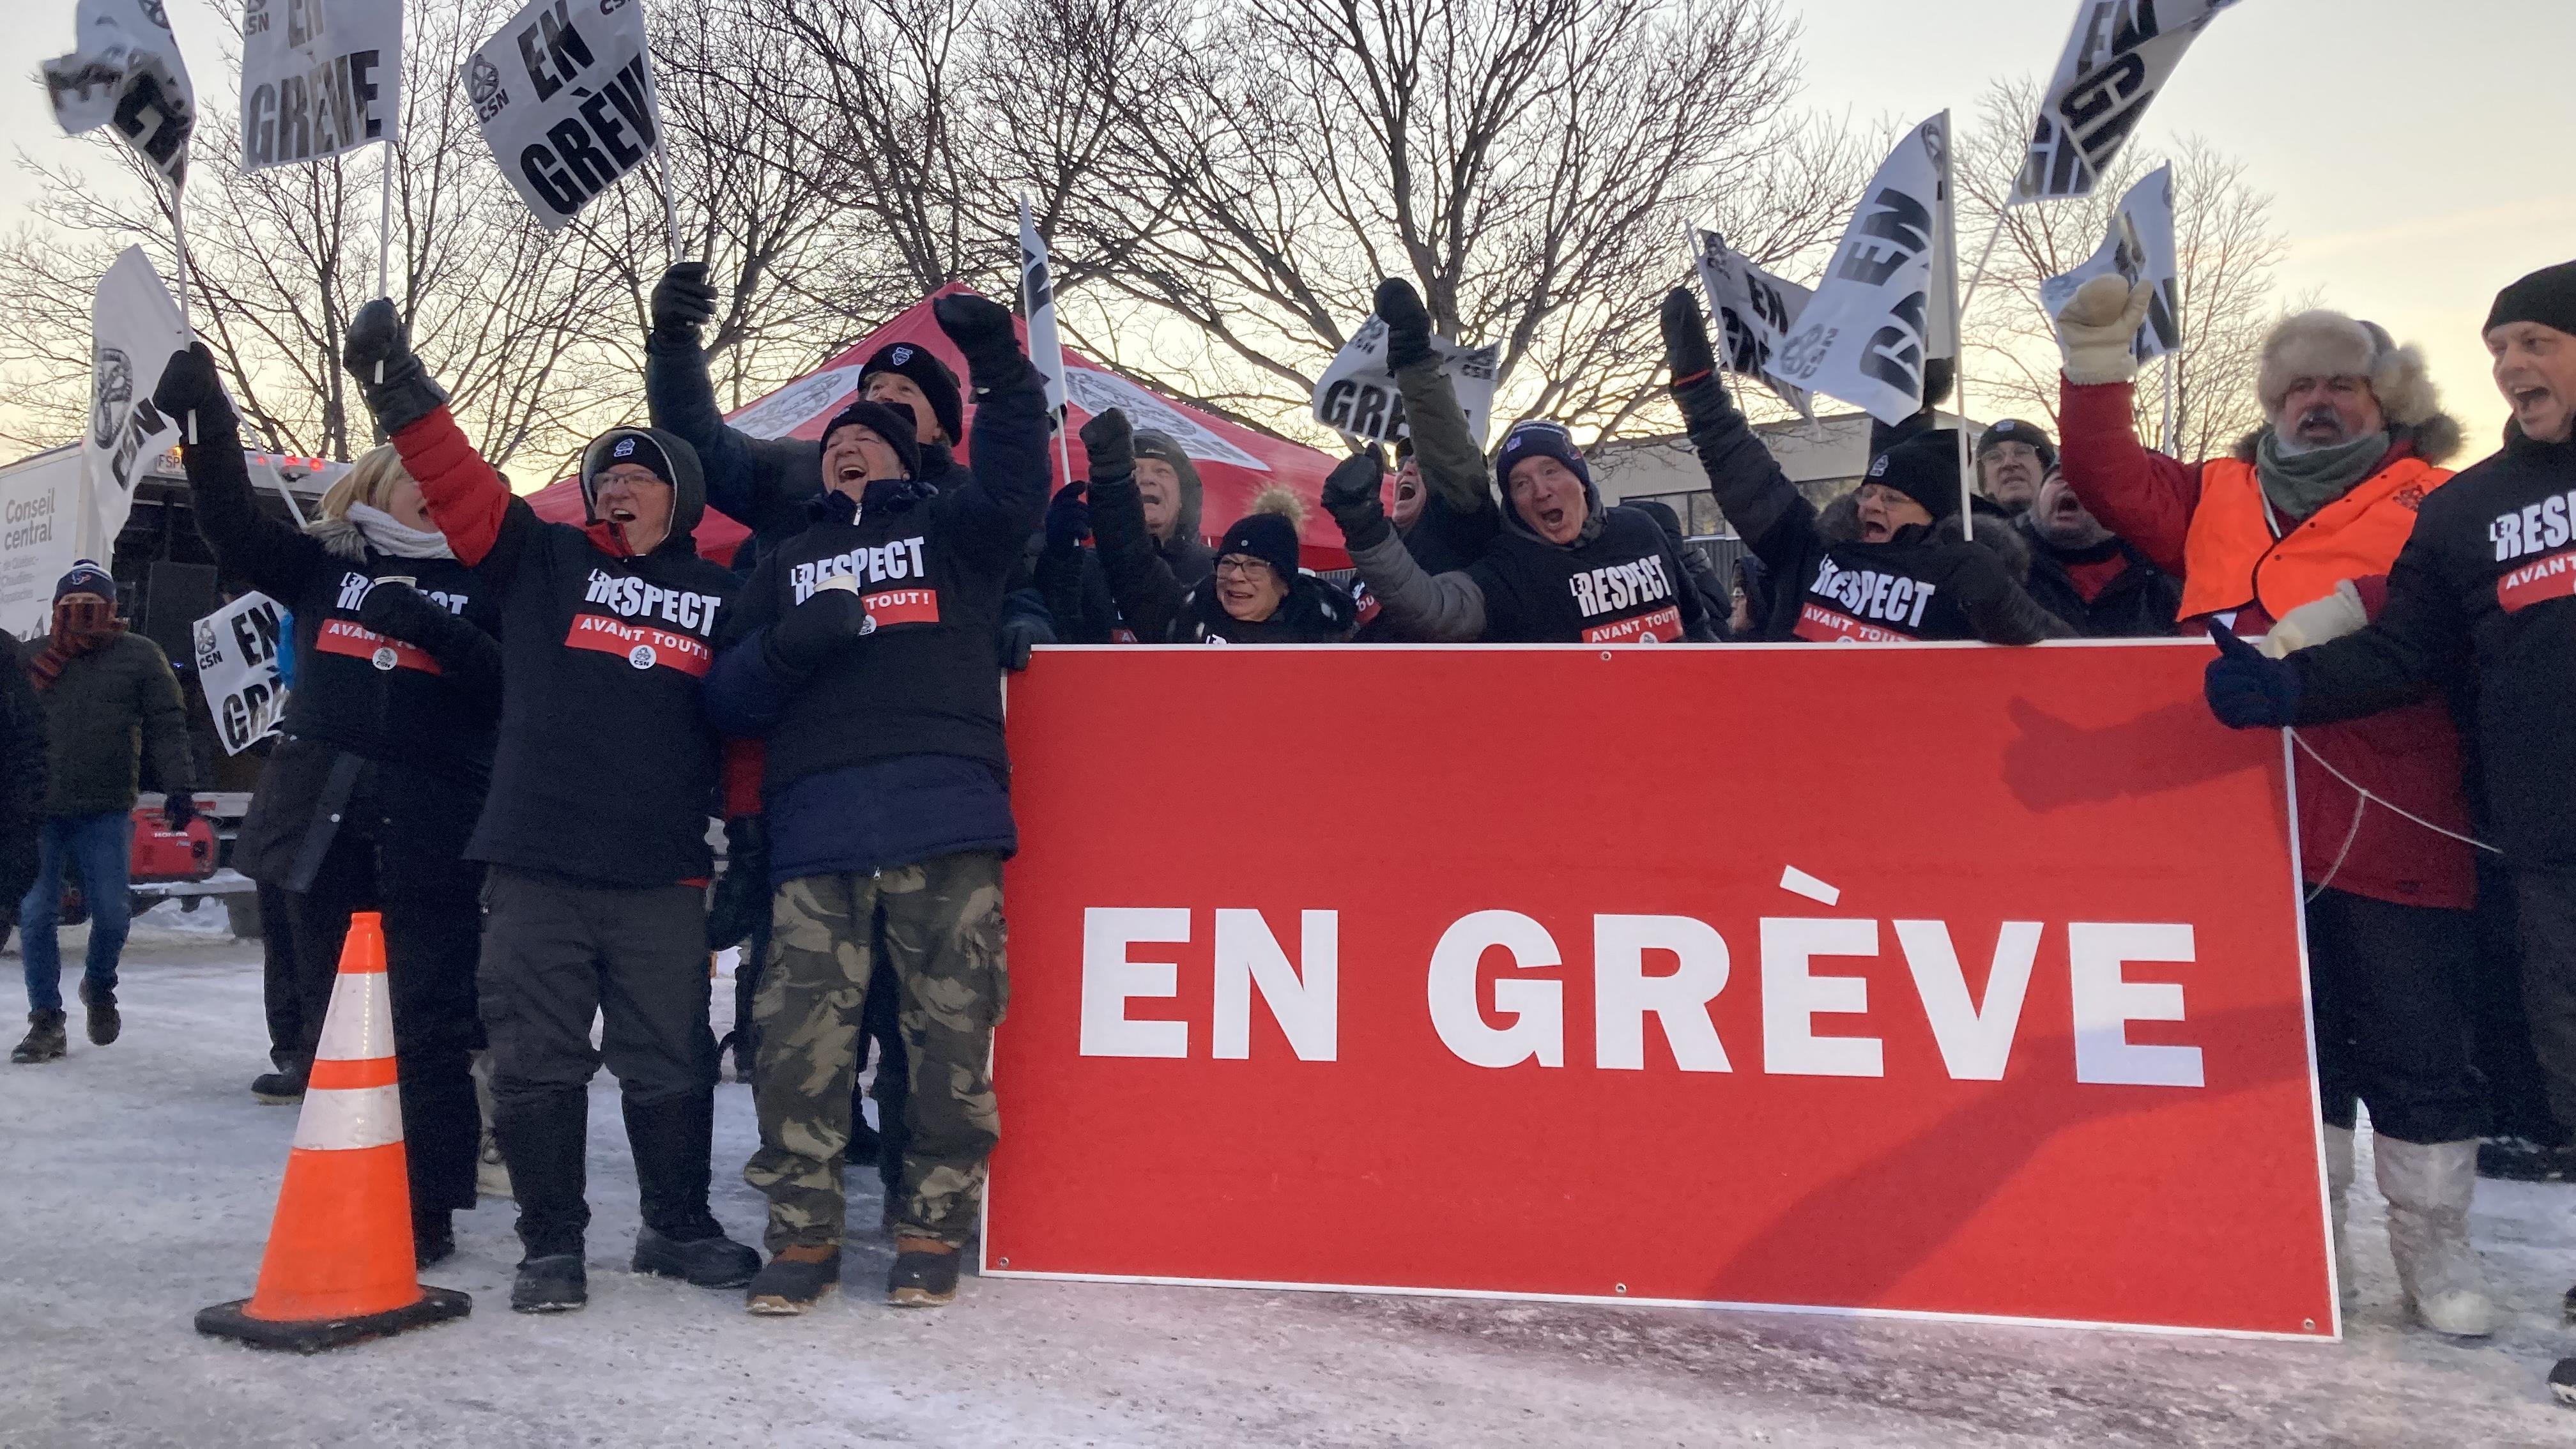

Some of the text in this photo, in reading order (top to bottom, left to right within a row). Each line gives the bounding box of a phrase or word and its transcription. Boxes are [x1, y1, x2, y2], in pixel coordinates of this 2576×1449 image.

[246, 12, 270, 35] SN
[518, 0, 595, 103] EN
[479, 88, 510, 124] CSN
[521, 52, 656, 215] GRÈV
[6, 487, 56, 525] Conseil
[4, 516, 52, 551] central
[585, 570, 721, 636] RESPECT
[1573, 554, 1672, 617] RESPECT
[231, 602, 280, 668] EN
[580, 618, 645, 641] AVANT
[1591, 620, 1640, 643] AVANT
[1804, 608, 1854, 631] AVANT
[200, 650, 223, 670] CSN
[1080, 865, 2204, 1087] EN GRÈVE
